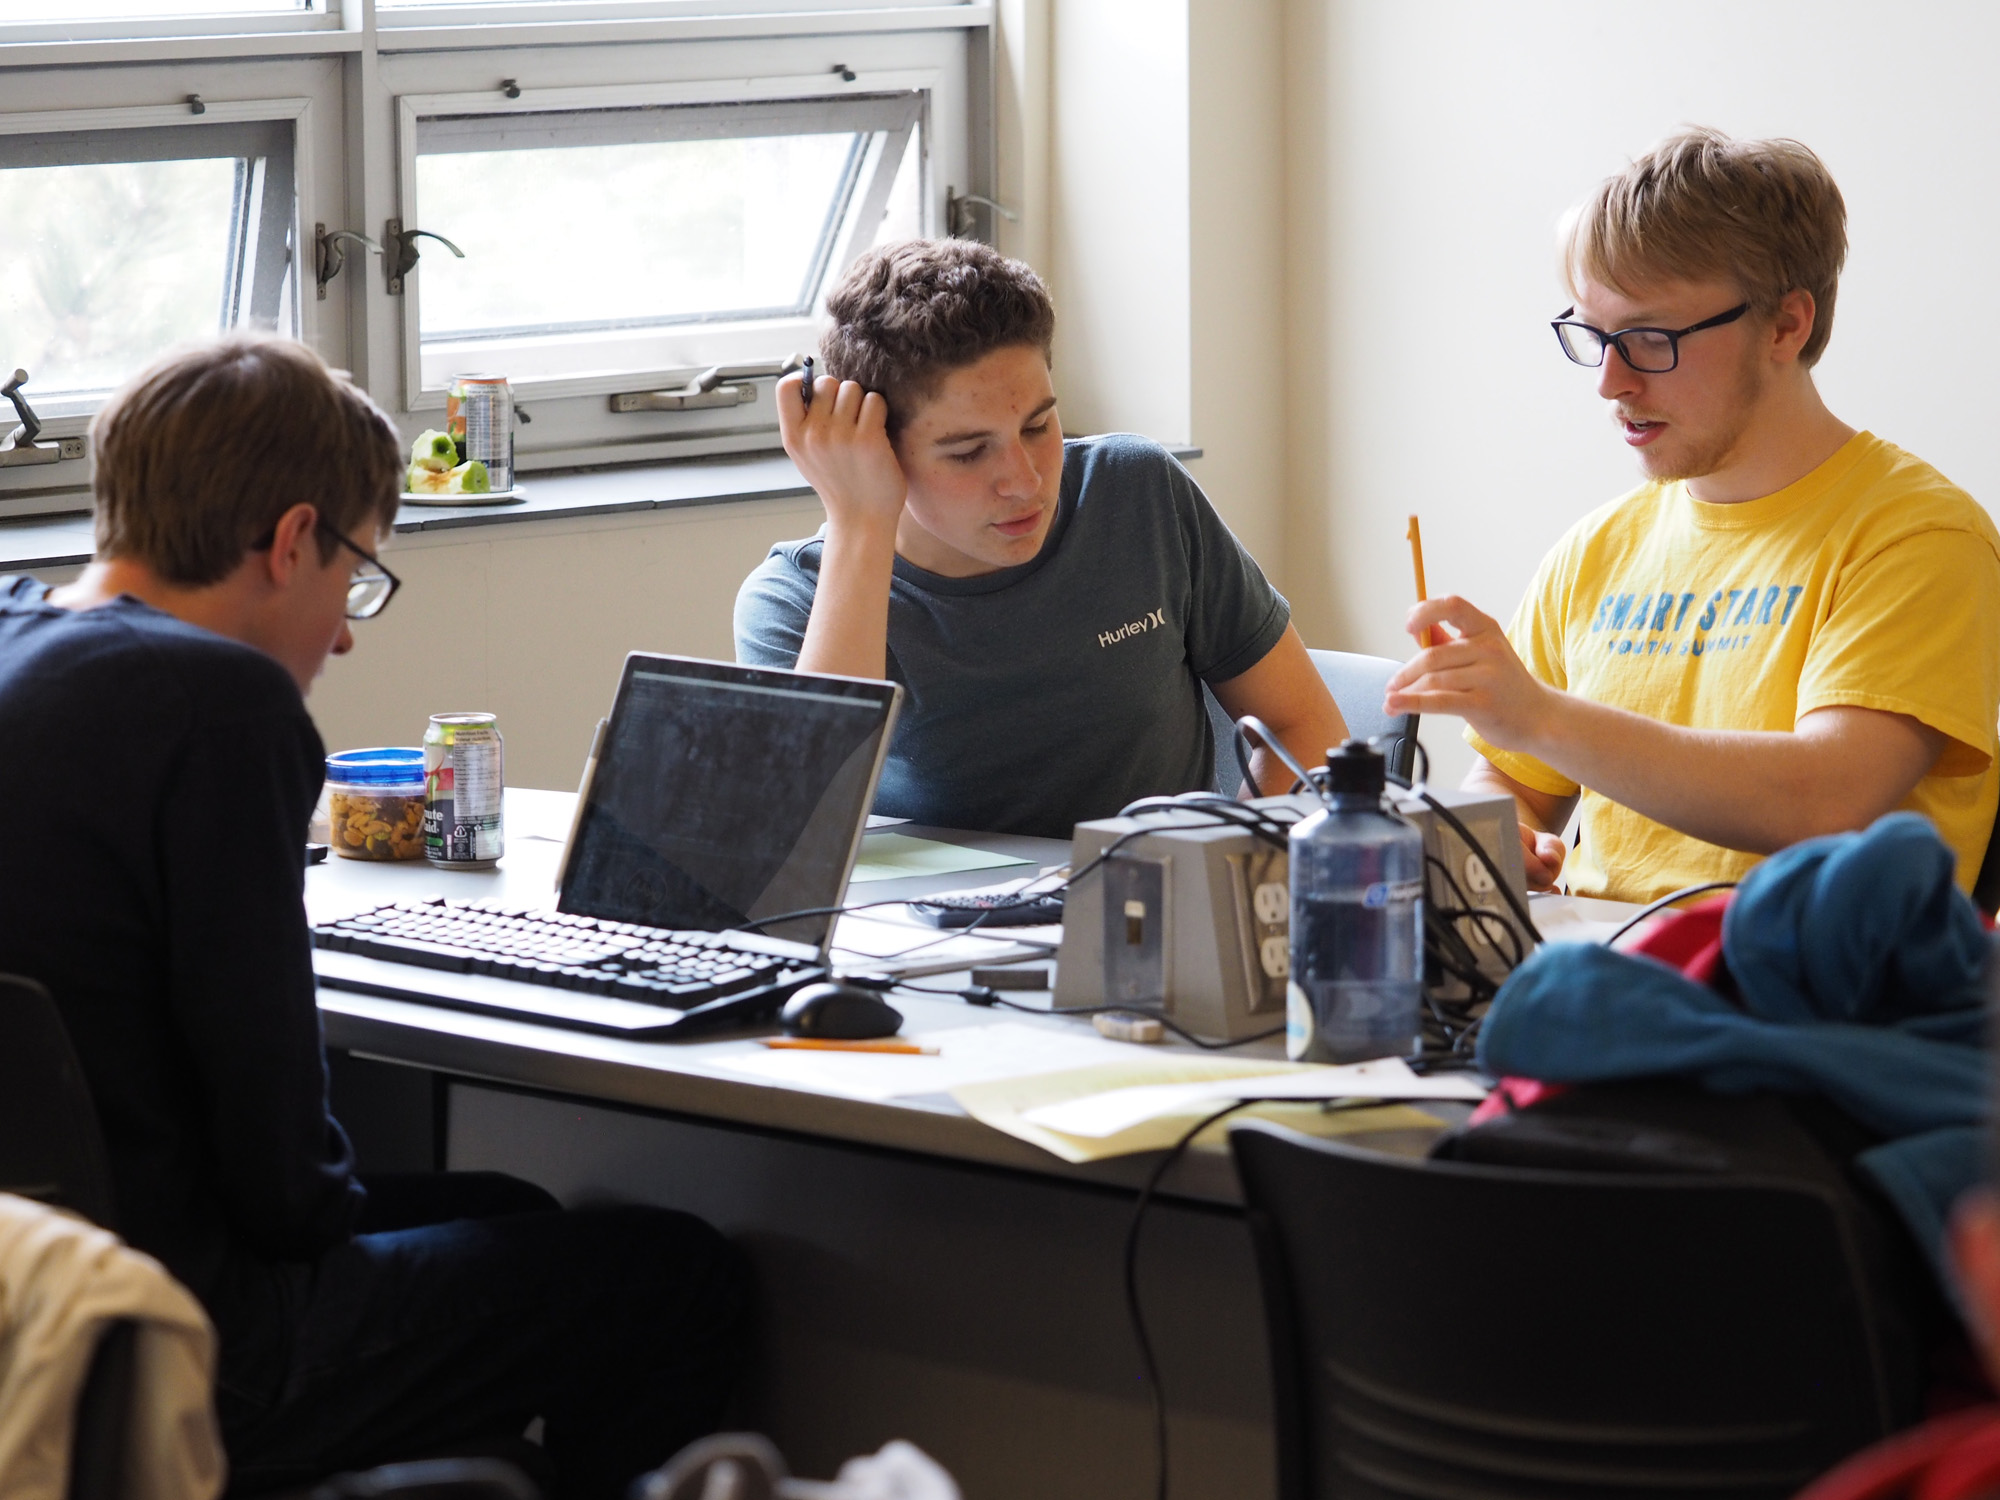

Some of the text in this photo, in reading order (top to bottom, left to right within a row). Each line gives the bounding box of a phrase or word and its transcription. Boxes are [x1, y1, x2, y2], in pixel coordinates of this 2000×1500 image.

[1592, 584, 1804, 632] SMART START
[1097, 617, 1148, 648] Hurley
[1608, 634, 1751, 657] YOUTH SUMMIT
